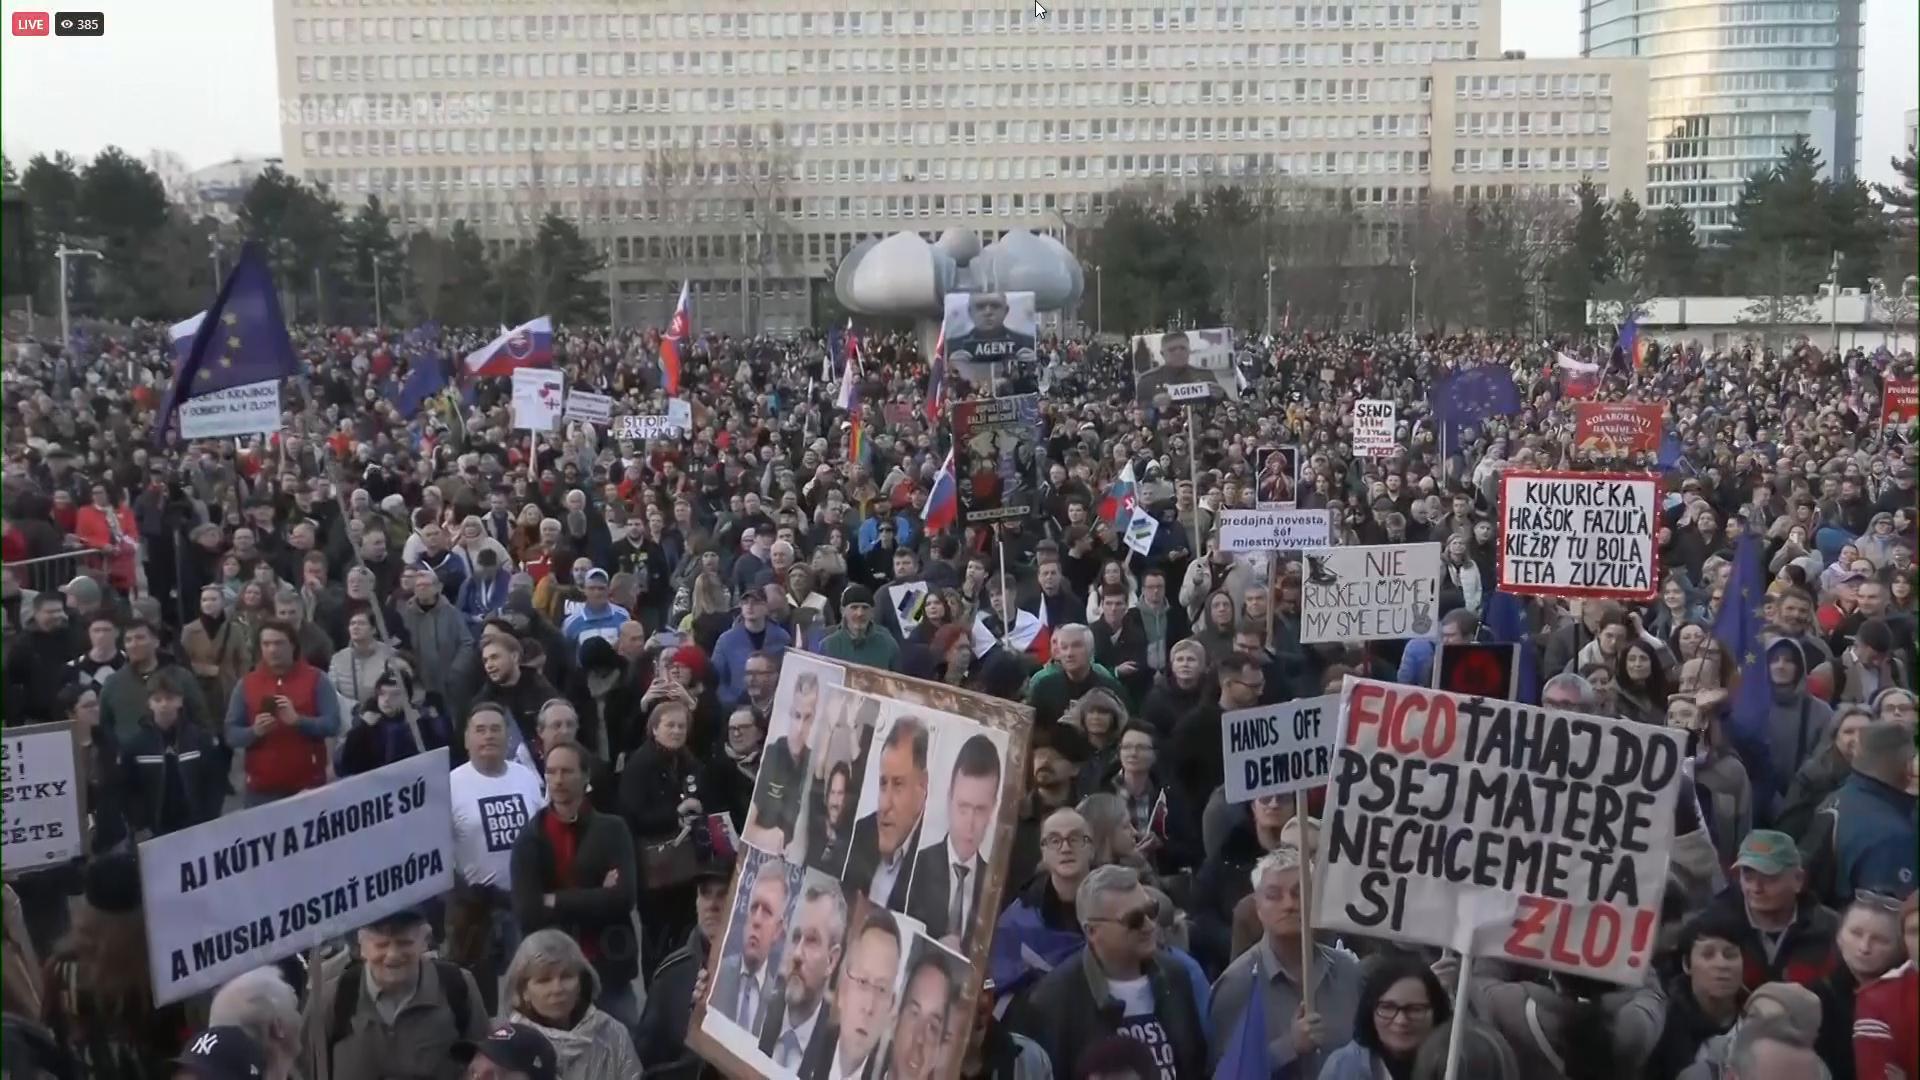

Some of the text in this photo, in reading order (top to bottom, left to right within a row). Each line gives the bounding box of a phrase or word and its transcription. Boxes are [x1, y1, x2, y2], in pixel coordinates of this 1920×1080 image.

[975, 341, 1016, 355] AGENT
[1173, 384, 1204, 397] AGENT
[624, 416, 668, 429] STOP
[1356, 403, 1393, 418] SEND
[1506, 532, 1560, 559] KIEŽBY
[1597, 537, 1642, 563] BOLA
[1365, 550, 1407, 578] NIE
[1511, 559, 1556, 584] TETA
[1303, 581, 1371, 609] RUSKEJ
[1305, 611, 1332, 638] MY
[1336, 609, 1371, 639] SME
[1230, 706, 1322, 753] HANDS OFF
[1346, 684, 1457, 759] FICO
[1602, 725, 1679, 793] DO
[1336, 749, 1657, 853] PSEJ MATERE
[180, 775, 427, 894] AJ KÚTY A ZÁHORIE SÚ
[488, 812, 526, 831] BOLO
[1328, 809, 1573, 899] NECHCEME
[171, 847, 444, 983] A MUSIA ZOSTAŤ EURÓPA
[1345, 871, 1408, 932] SI
